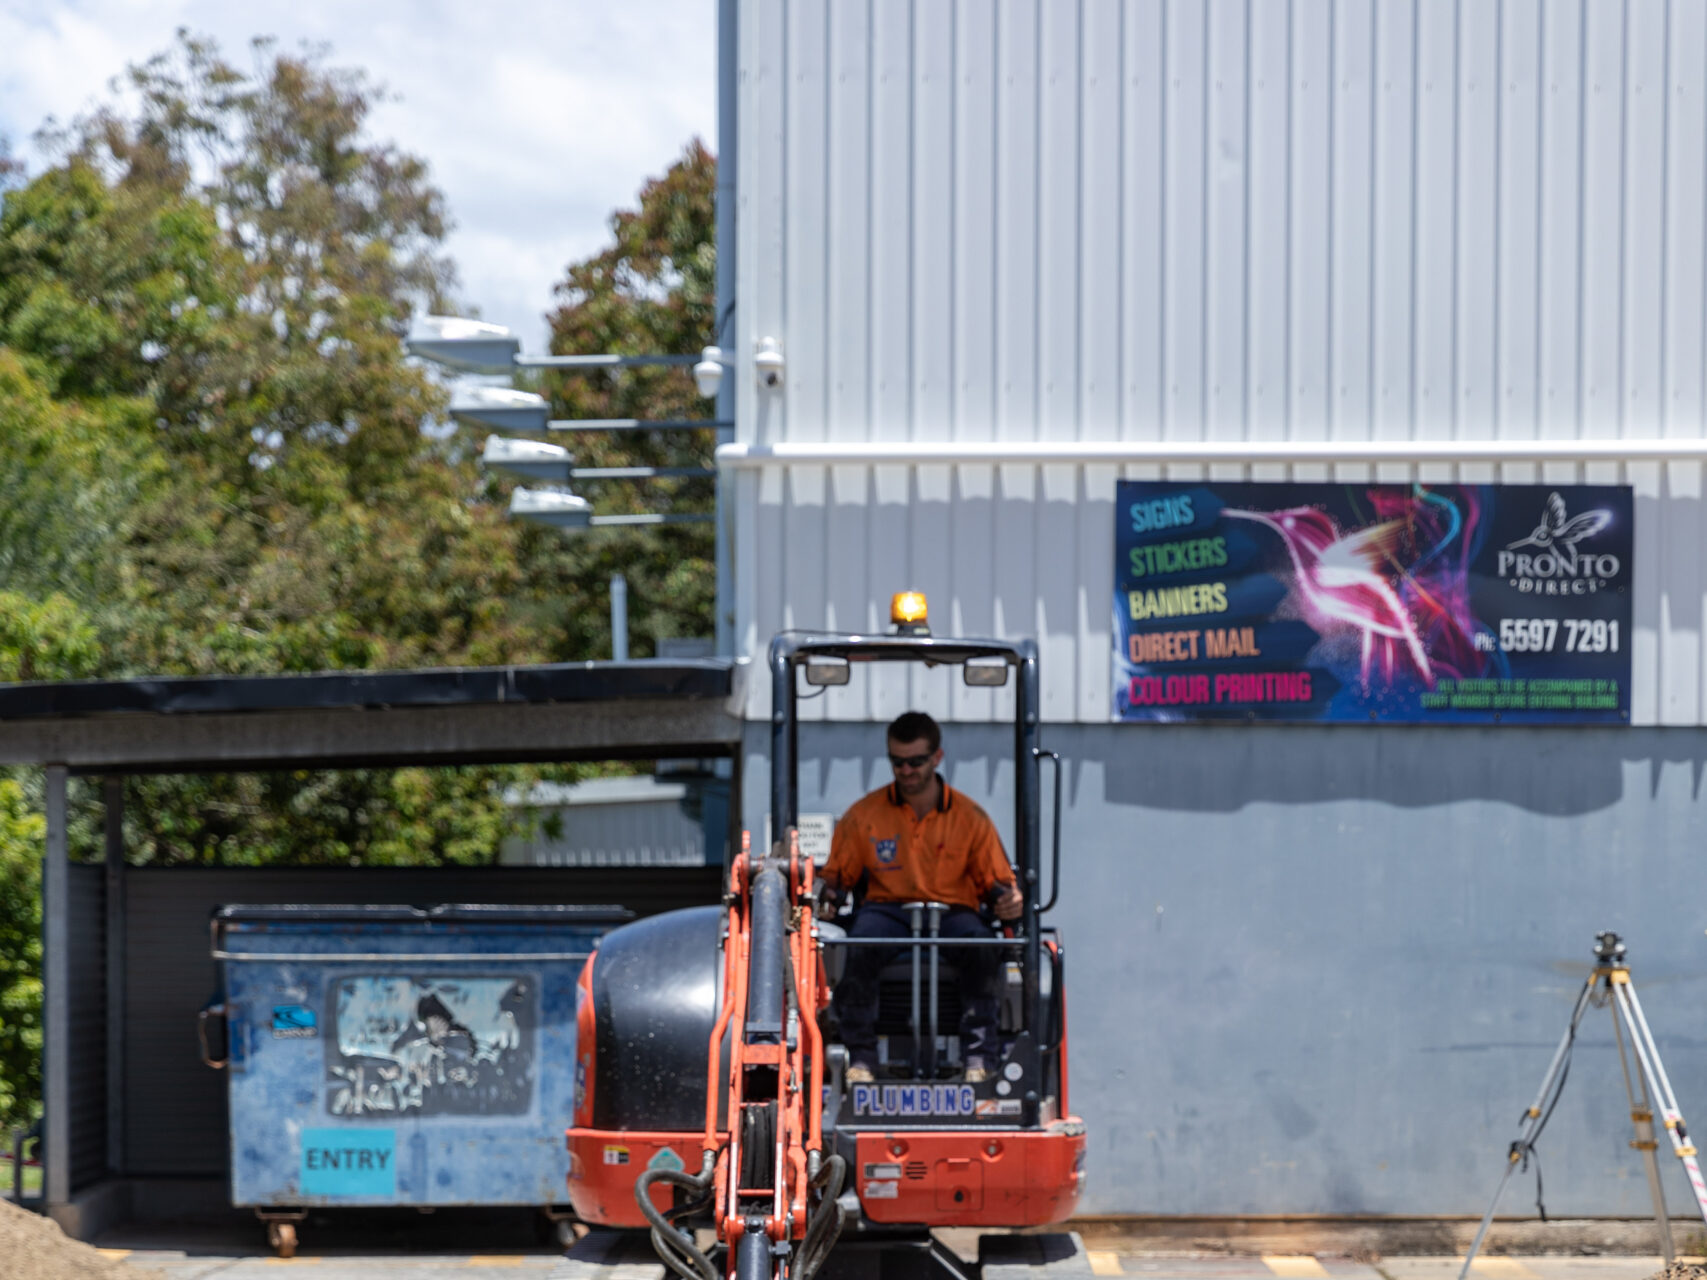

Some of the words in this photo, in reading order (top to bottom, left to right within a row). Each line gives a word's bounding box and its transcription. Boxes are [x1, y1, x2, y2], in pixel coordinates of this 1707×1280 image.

[1130, 494, 1195, 533] SIGNS
[1129, 536, 1228, 577] STICKERS
[1498, 550, 1620, 578] PRONTO
[1128, 582, 1228, 621] BANNERS
[1517, 577, 1598, 595] DIRECT
[1128, 629, 1201, 664] DIRECT
[1204, 626, 1262, 659] MAIL
[1499, 618, 1558, 652] 5597
[1563, 618, 1619, 652] 7291
[1129, 674, 1210, 705] COLOUR
[1215, 671, 1312, 702] PRINTING
[855, 1085, 974, 1115] PLUMBING
[306, 1148, 391, 1170] ENTRY
